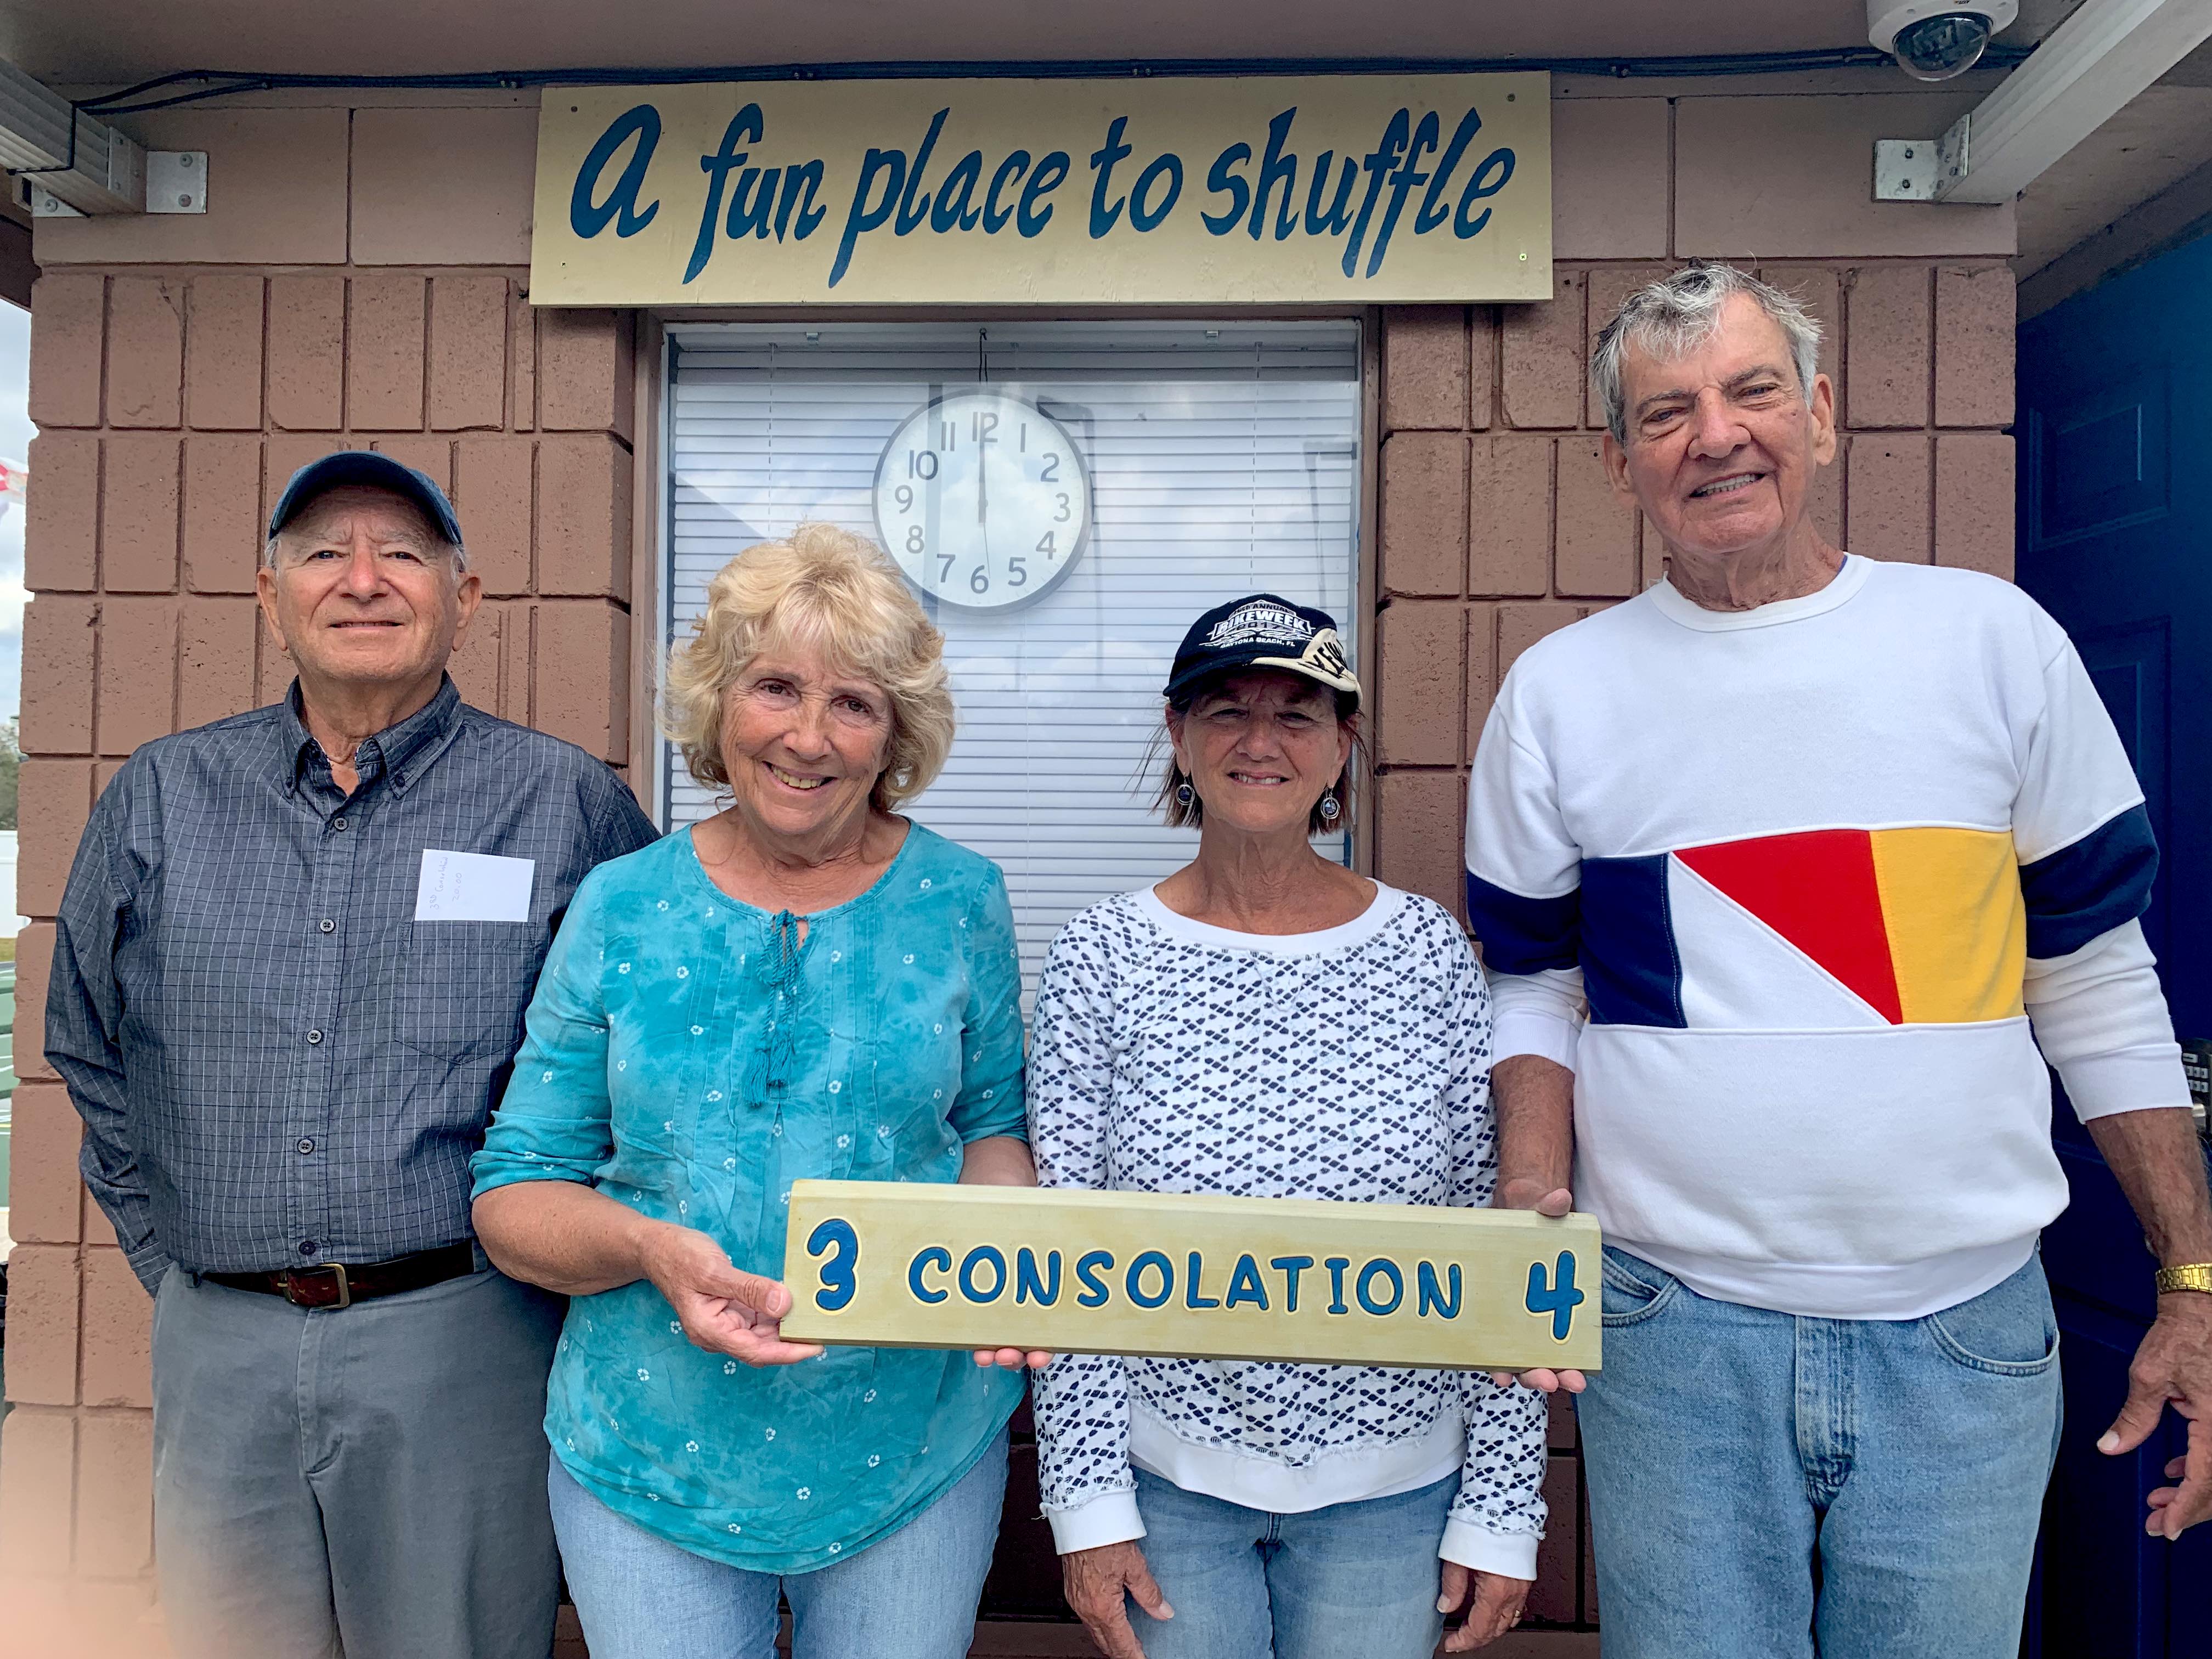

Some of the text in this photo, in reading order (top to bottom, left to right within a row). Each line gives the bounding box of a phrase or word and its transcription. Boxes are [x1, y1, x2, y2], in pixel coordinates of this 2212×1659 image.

[682, 103, 826, 284] fun
[828, 108, 1070, 287] place
[1089, 117, 1183, 239] to
[1201, 108, 1516, 278] shuffle
[941, 421, 956, 451] 11
[972, 411, 998, 442] 12
[1020, 423, 1026, 453] 1
[909, 449, 939, 480] 10
[1040, 453, 1059, 482] 2
[895, 485, 913, 514] 9
[1053, 493, 1071, 522] 3
[906, 525, 924, 554] 8
[1035, 531, 1057, 560] 4
[936, 554, 956, 583] 7
[970, 565, 989, 594] 6
[1008, 557, 1027, 586] 5
[1252, 603, 1289, 612] ANNUAL
[1236, 621, 1280, 630] 2017
[1220, 637, 1254, 648] DAYTONA
[452, 872, 462, 902] 20.00
[807, 1219, 1584, 1340] 3 CONSOLATION 4
